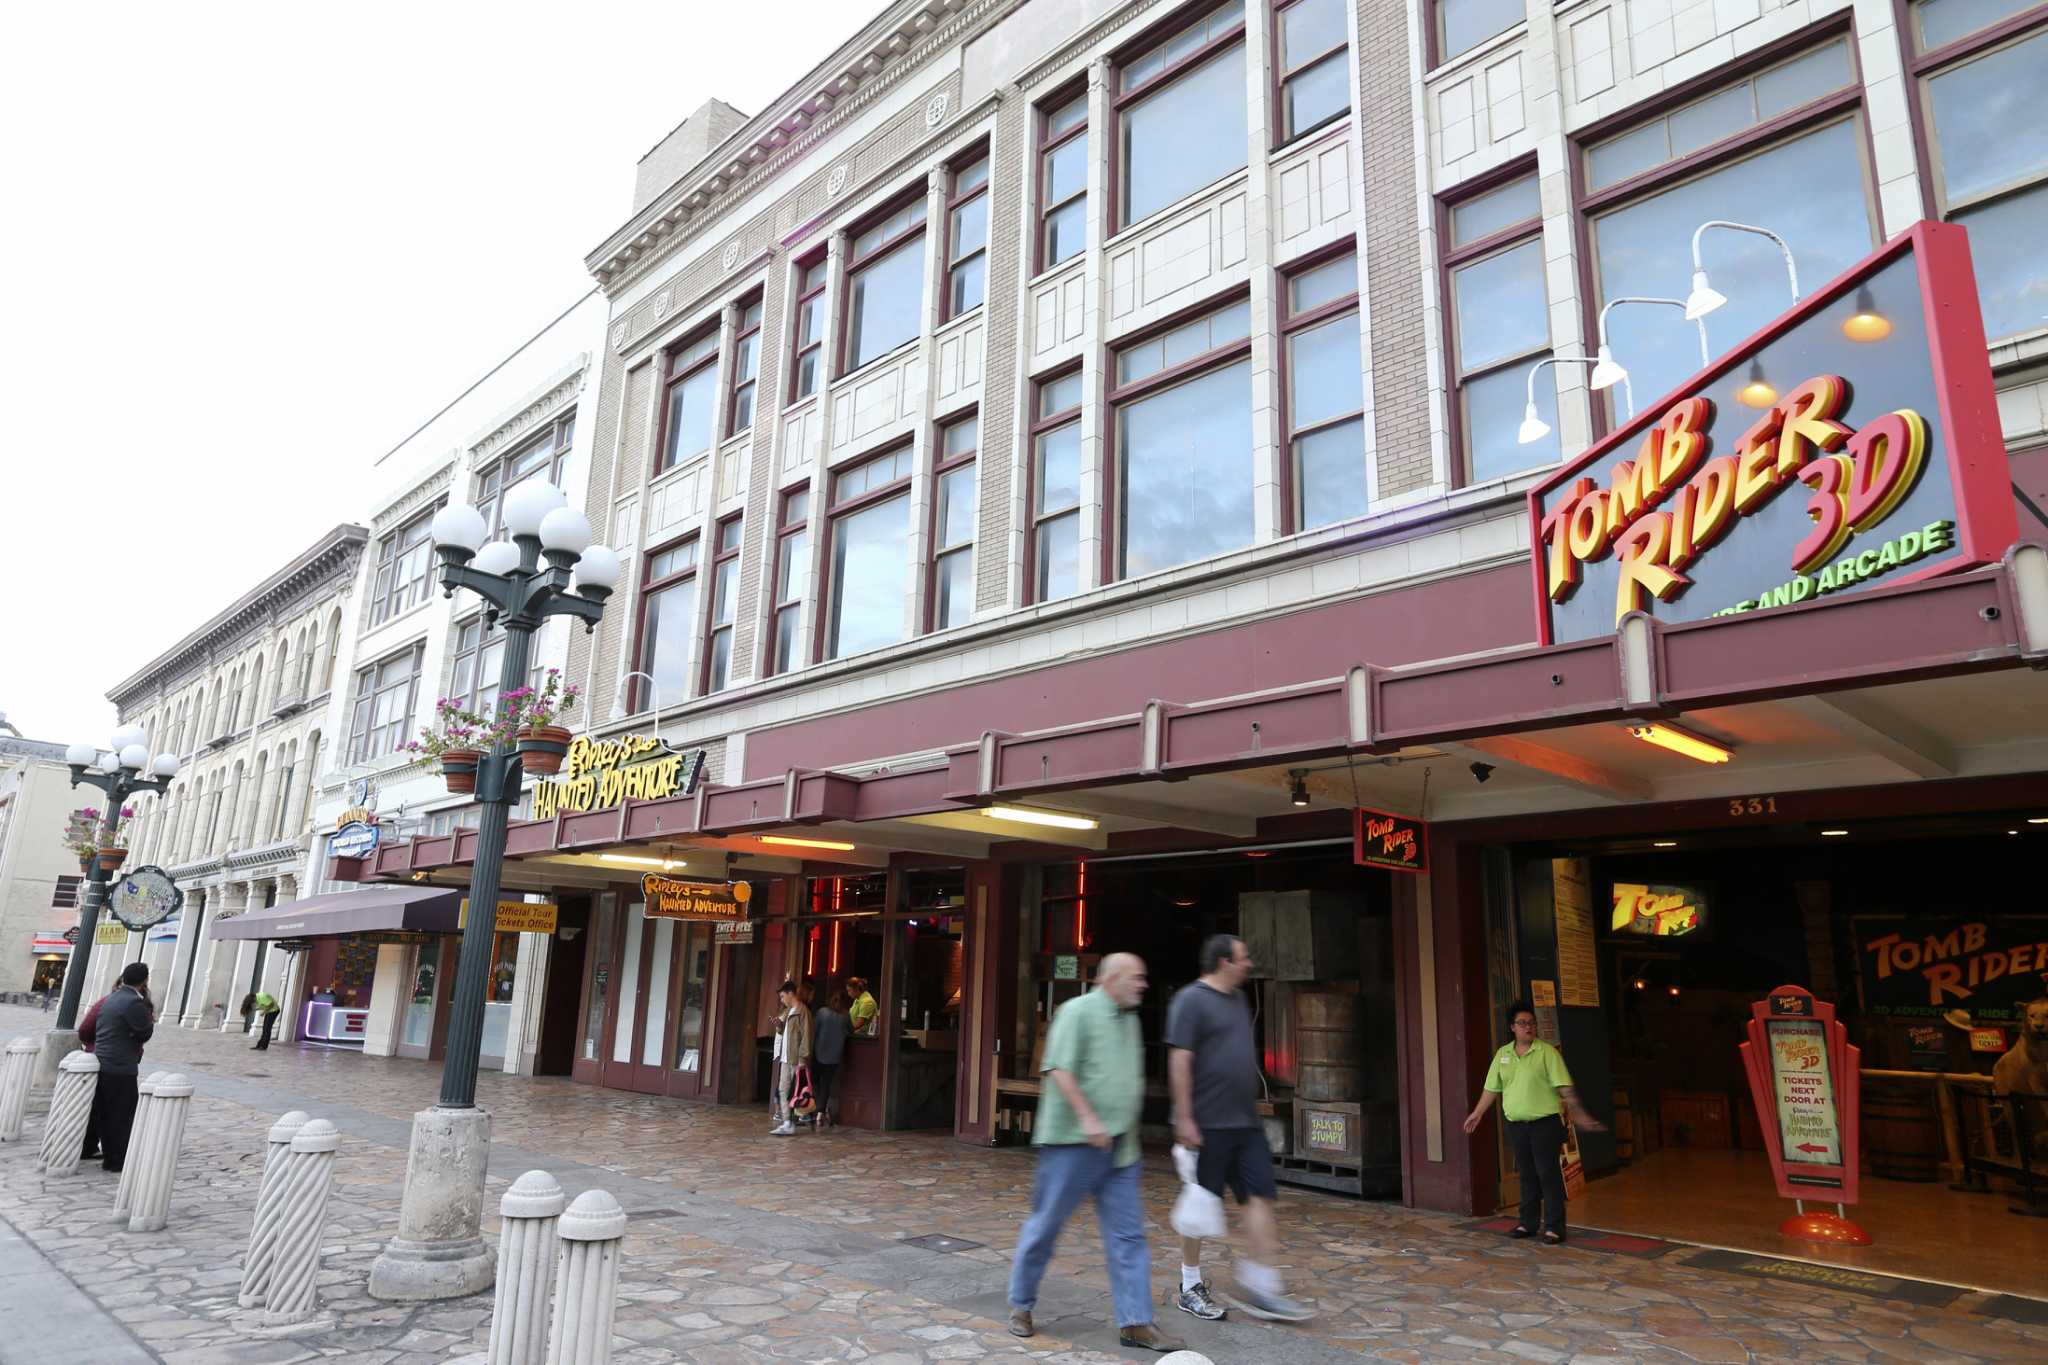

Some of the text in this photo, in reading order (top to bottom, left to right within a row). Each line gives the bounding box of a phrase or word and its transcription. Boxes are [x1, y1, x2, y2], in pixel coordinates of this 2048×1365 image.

[1541, 397, 1715, 604] TOMB
[1613, 374, 1854, 629] RIDER
[1792, 408, 1926, 577] 3D
[1758, 520, 1953, 610] AND ARCADE
[534, 754, 684, 820] HAUNTED ADVENTURE
[1729, 797, 1777, 816] 331
[1366, 818, 1394, 842] TOMB
[1383, 829, 1414, 855] RIDER
[498, 905, 530, 917] Official
[660, 895, 737, 916] HAUNTED ADVENTURE
[528, 918, 554, 930] Office
[1866, 922, 1987, 980] TOMB
[1893, 1006, 1971, 1018] ADVENT
[1800, 1055, 1820, 1070] 3D
[1782, 1076, 1823, 1085] TICKETS
[1784, 1095, 1826, 1105] DOOR AT
[1791, 1087, 1816, 1095] NEXT
[1312, 1119, 1344, 1132] TALK TO
[1312, 1130, 1344, 1145] STUMPY
